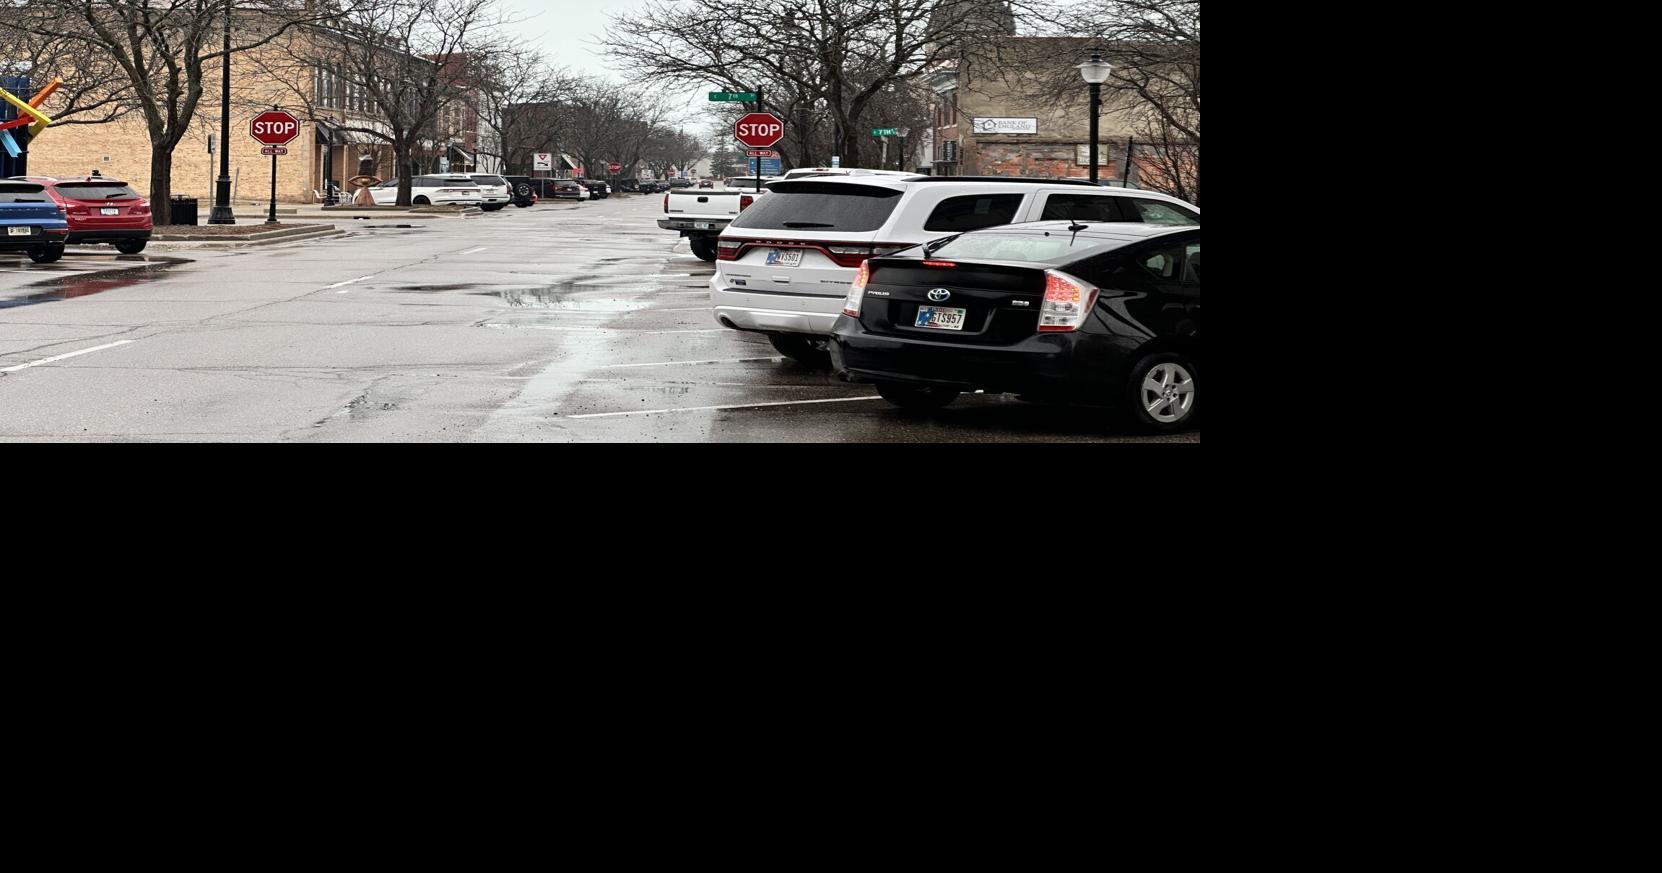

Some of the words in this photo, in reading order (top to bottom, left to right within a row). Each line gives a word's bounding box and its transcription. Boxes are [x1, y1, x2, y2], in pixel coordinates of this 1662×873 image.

[254, 121, 295, 135] STOP
[738, 123, 780, 137] STOP
[931, 312, 962, 324] GTS957
